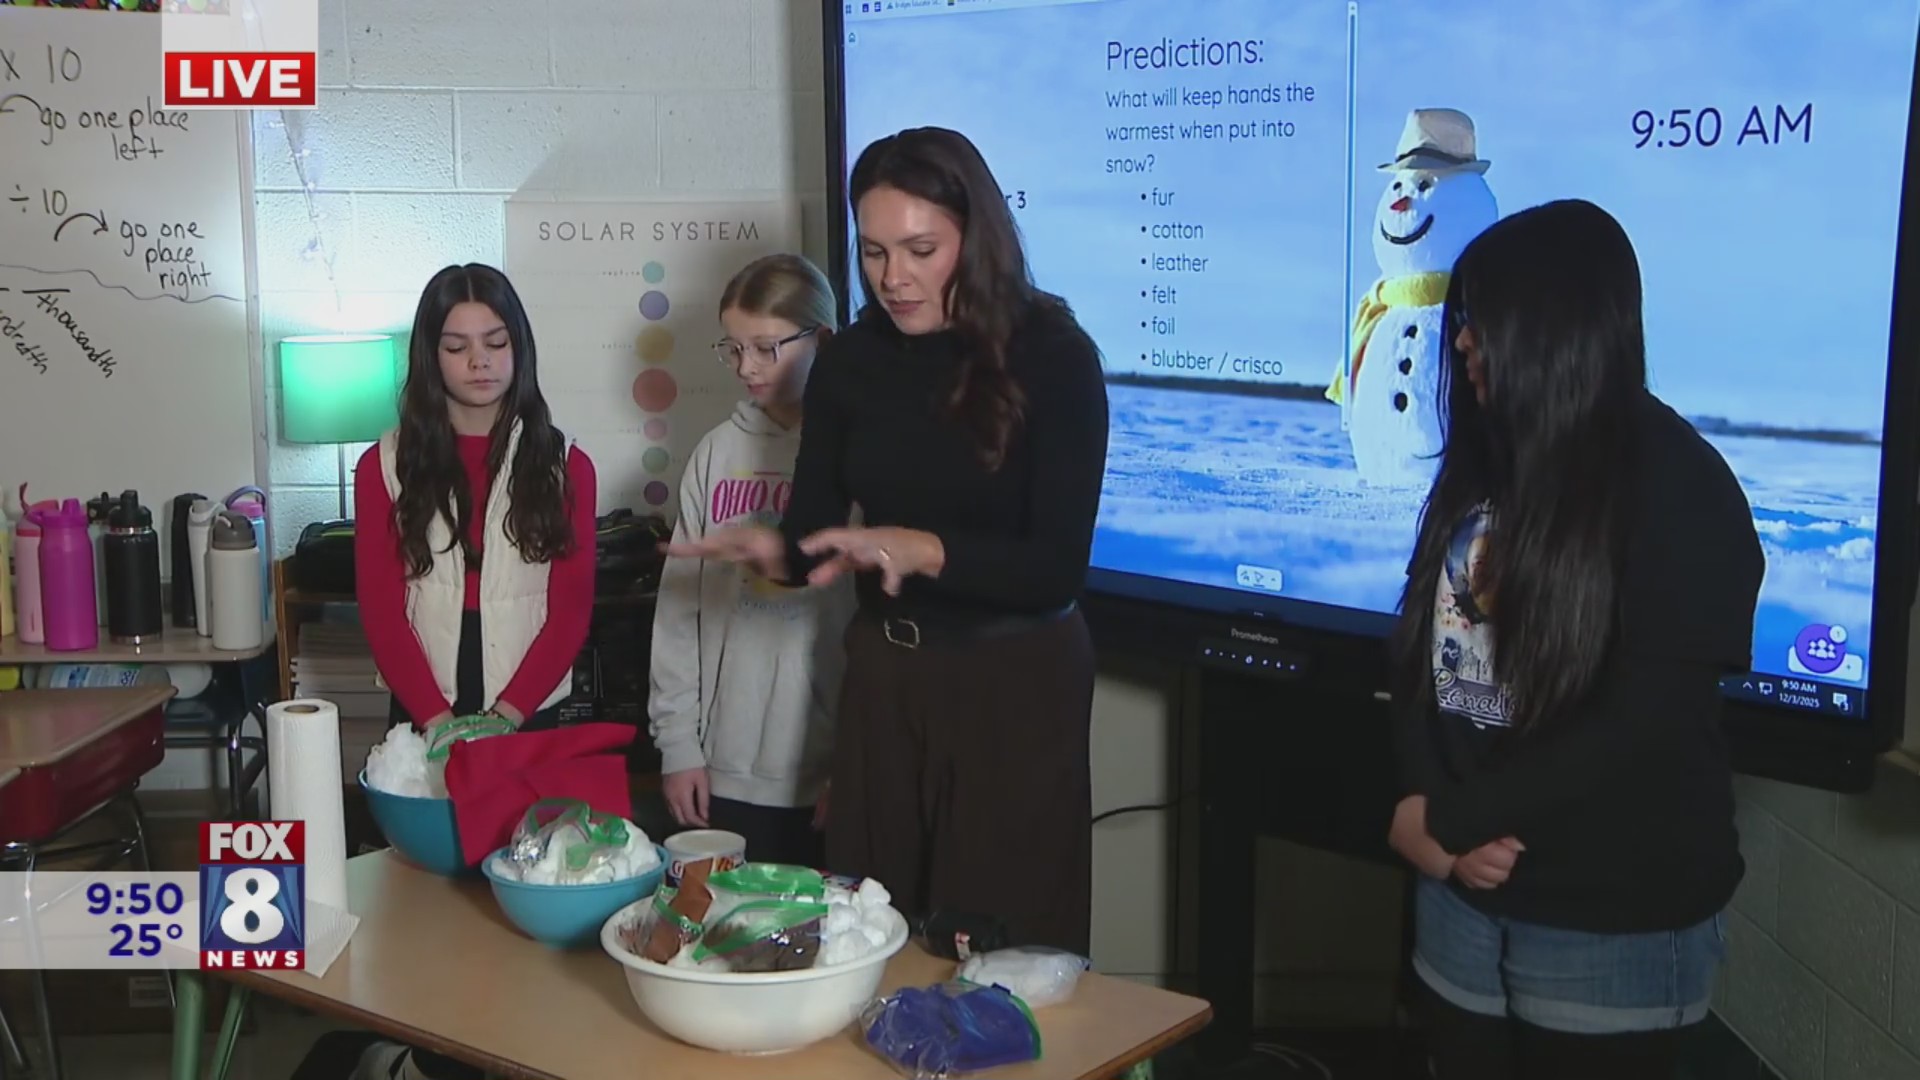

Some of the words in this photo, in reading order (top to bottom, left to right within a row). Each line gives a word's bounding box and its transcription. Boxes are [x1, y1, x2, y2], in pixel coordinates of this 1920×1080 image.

[47, 44, 82, 84] 10
[1106, 37, 1265, 71] Predictions:
[1106, 89, 1148, 108] What
[1152, 87, 1177, 107] will
[1182, 86, 1223, 109] keep
[1228, 83, 1281, 106] hands
[1286, 82, 1316, 103] the
[41, 107, 67, 146] go
[79, 109, 124, 130] one
[129, 96, 191, 143] place
[1106, 122, 1175, 141] warmest
[1180, 120, 1223, 140] when
[1229, 120, 1257, 143] put
[1262, 119, 1296, 139] into
[1632, 107, 1722, 149] 9:50
[1736, 103, 1812, 146] AM
[113, 133, 165, 161] left
[1106, 154, 1155, 174] snow?
[43, 188, 68, 217] 10
[1017, 191, 1026, 209] 3
[1152, 187, 1175, 207] fur
[120, 220, 148, 257] go
[160, 221, 206, 240] one
[539, 221, 636, 242] SOLAR
[653, 220, 760, 241] SYSTEM
[1152, 222, 1204, 240] cotton
[145, 238, 197, 273] place
[1152, 253, 1209, 273] leather
[159, 262, 212, 304] right
[1152, 286, 1177, 305] felt
[36, 294, 118, 379] thousandth
[1152, 316, 1175, 335] foil
[1152, 349, 1214, 371] blubber
[1233, 356, 1283, 377] crisco
[711, 479, 769, 524] OHIO
[1230, 628, 1279, 645] Promethean
[1800, 682, 1817, 693] AM
